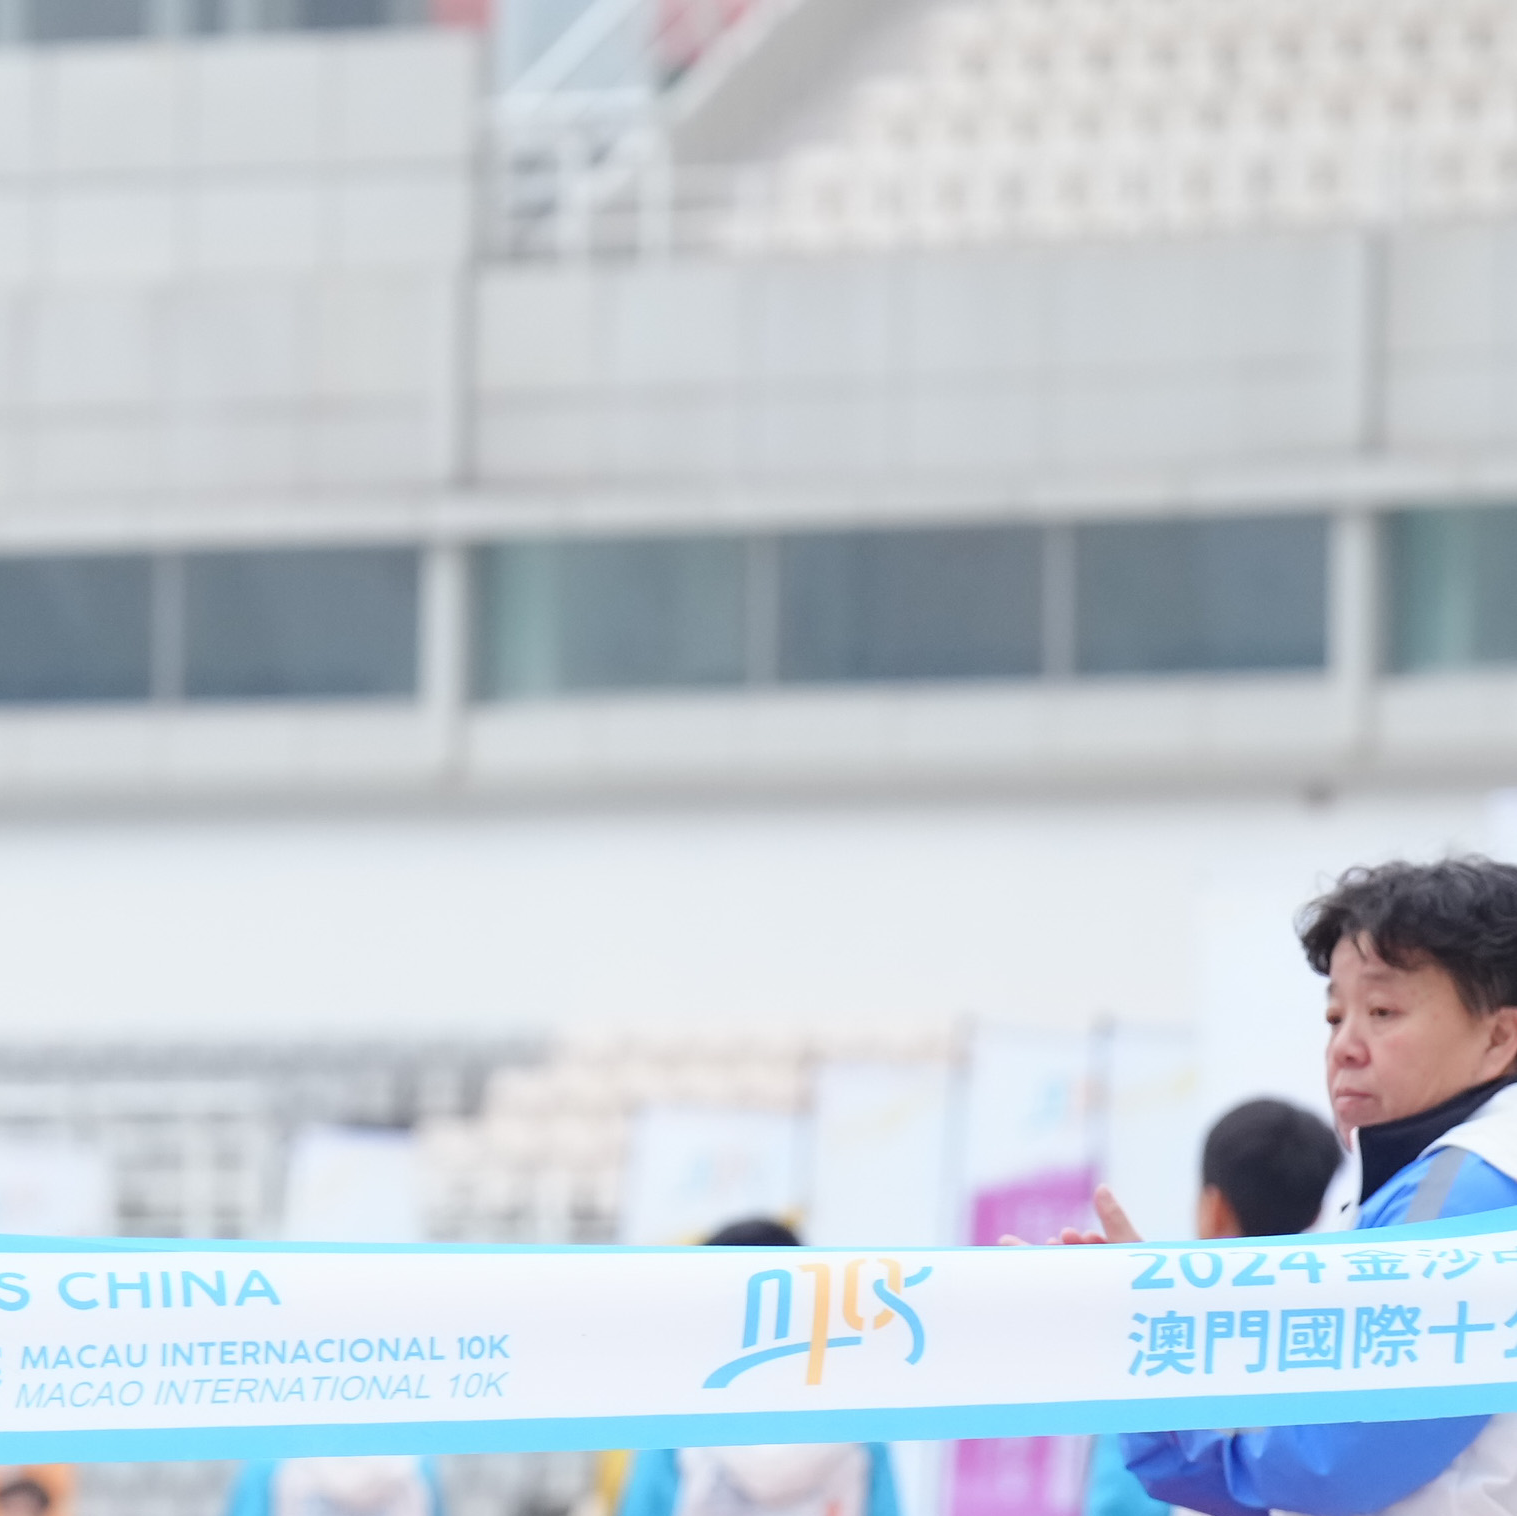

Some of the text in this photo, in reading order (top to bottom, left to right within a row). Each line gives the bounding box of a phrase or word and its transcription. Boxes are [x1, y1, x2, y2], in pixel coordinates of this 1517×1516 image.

[57, 1269, 283, 1312] CHINA
[1129, 1250, 1328, 1291] 2024
[20, 1333, 511, 1370] MACAU INTERNACIONAL 10K
[1128, 1301, 1517, 1377] 澳門國際十
[15, 1371, 507, 1410] MACAO INTERNATIONAL 10K
